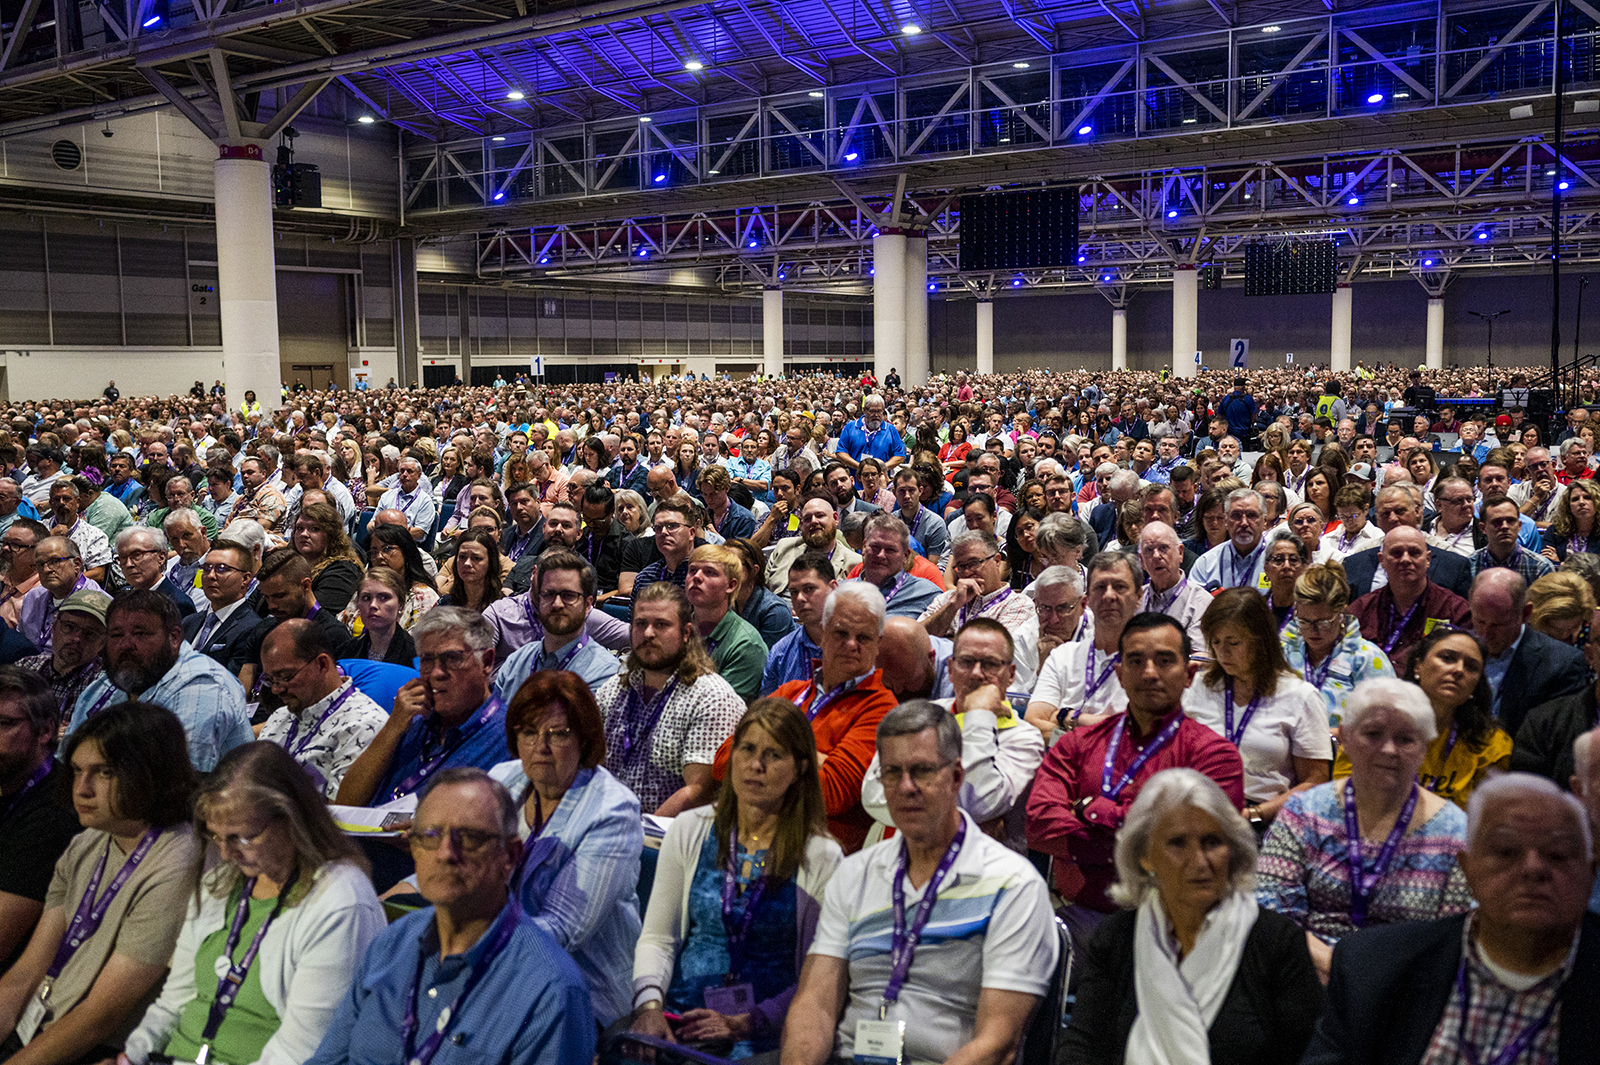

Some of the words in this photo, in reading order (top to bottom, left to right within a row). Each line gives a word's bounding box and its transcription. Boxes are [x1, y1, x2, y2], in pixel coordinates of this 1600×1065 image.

[248, 147, 259, 156] D-9
[192, 284, 213, 293] Gate
[200, 297, 206, 305] 2
[1194, 352, 1200, 364] 4
[1234, 340, 1245, 367] 2
[1288, 354, 1292, 362] 7
[535, 356, 541, 375] 1
